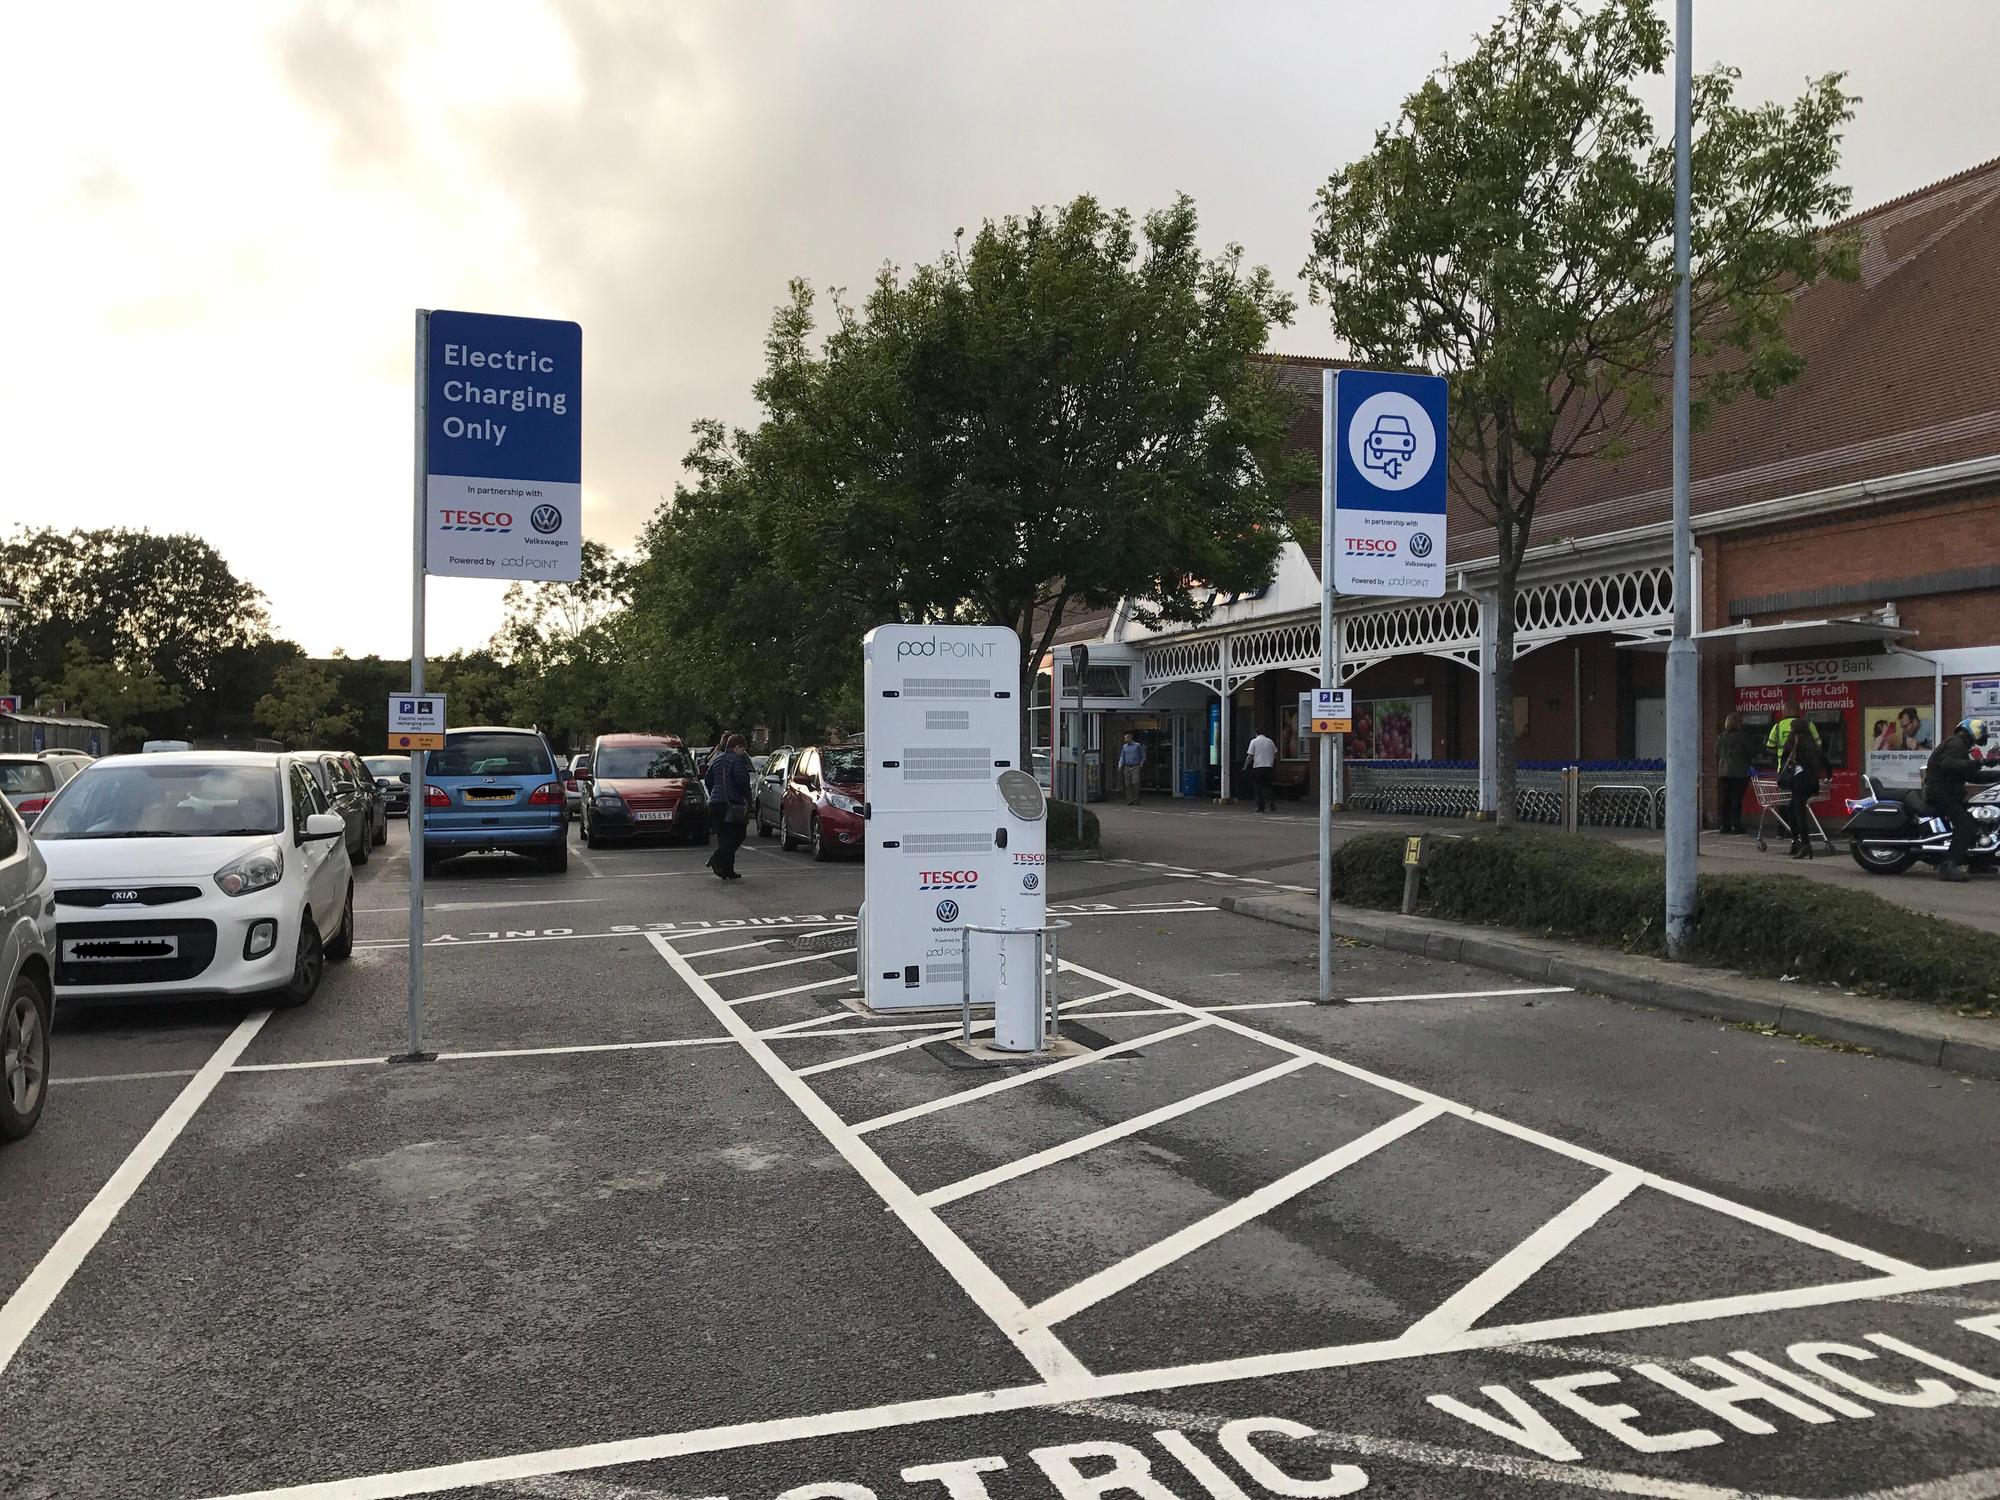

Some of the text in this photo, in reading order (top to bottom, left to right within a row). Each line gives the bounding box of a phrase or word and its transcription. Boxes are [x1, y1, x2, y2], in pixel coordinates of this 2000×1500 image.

[444, 343, 555, 373] Electric
[443, 380, 567, 415] Charging
[442, 416, 507, 446] Only
[467, 486, 543, 497] In partnership with
[440, 509, 513, 527] TESCO
[1371, 519, 1405, 527] partnership
[524, 537, 569, 547] Volkswagen
[1345, 538, 1397, 552] TESCO
[449, 555, 559, 569] Powered by pod POINT
[1404, 560, 1437, 568] Volkswagen
[1351, 577, 1377, 585] Powered
[1377, 578, 1385, 586] by
[1405, 579, 1430, 587] POINT
[897, 634, 997, 662] pod POINT
[1783, 659, 1874, 677] TESCO Bank
[1740, 687, 1783, 699] Free Cash
[1801, 683, 1848, 697] Free Cash
[1735, 700, 1786, 712] withdrawal
[1012, 853, 1045, 862] TESCO
[919, 870, 979, 884] TESCO
[116, 891, 133, 899] KIA
[430, 928, 573, 942] ONLY
[1426, 1315, 2000, 1461] VEHICL
